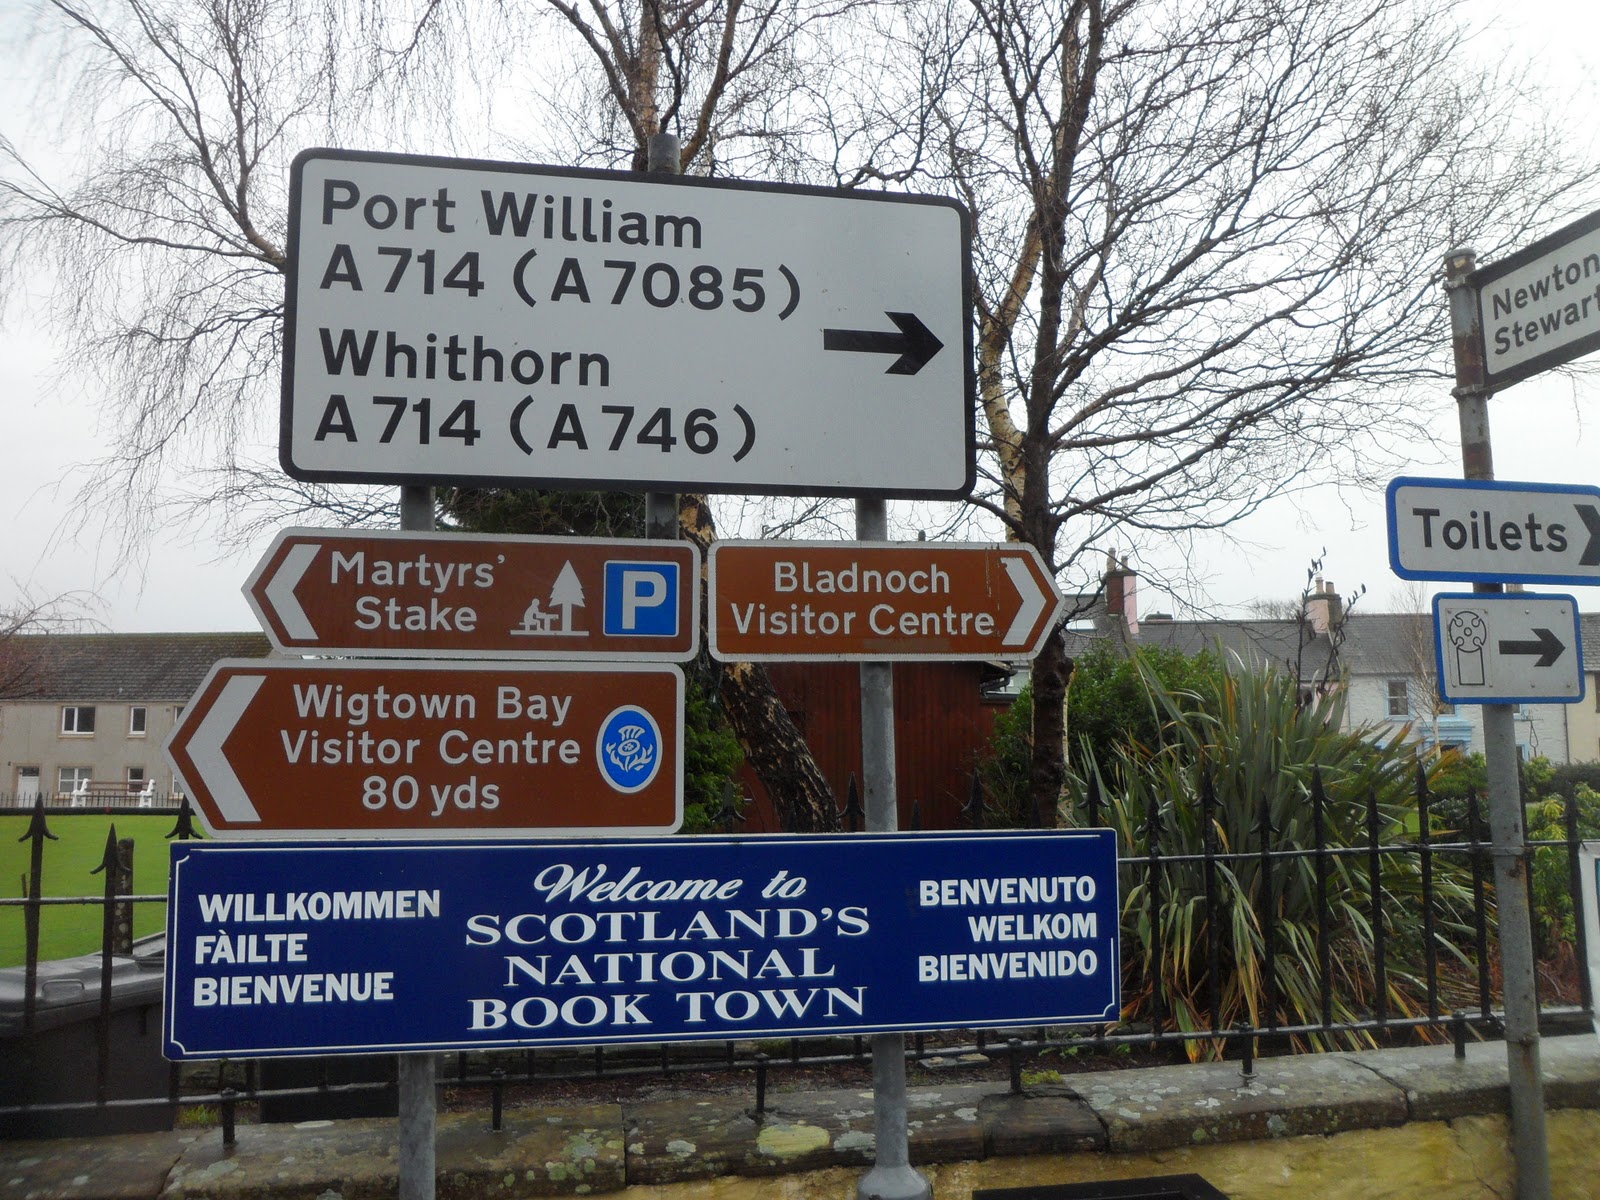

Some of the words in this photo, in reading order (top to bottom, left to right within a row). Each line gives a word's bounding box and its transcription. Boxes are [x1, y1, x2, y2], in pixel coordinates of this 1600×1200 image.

[323, 179, 456, 233] Port
[481, 190, 702, 249] William
[1492, 253, 1600, 321] Newton
[319, 328, 610, 387] Whithorn
[1412, 508, 1568, 553] Toilets
[331, 551, 505, 594] Martyrs'
[774, 561, 951, 594] Bladnoch
[354, 596, 477, 632] Stake
[622, 571, 667, 630] P
[731, 603, 856, 635] Visitor
[869, 604, 995, 635] Centre
[293, 684, 477, 725] Wigtown
[497, 686, 572, 726] Bay
[280, 730, 420, 764] Visitor
[438, 731, 580, 764] Centre
[362, 775, 419, 810] 80
[430, 775, 500, 817] yds
[534, 863, 744, 904] Welcome
[761, 869, 807, 899] to
[919, 875, 1097, 908] BENVENUTO
[198, 889, 441, 923] WILLKOMMEN
[465, 906, 870, 946] SCOTLAND'S
[967, 912, 1099, 943] WELKOM
[195, 931, 309, 965] FÀILTE
[503, 947, 836, 988] NATIONAL
[918, 948, 1099, 983] BIENVENIDO
[193, 971, 395, 1008] BIENVENUE
[466, 993, 654, 1031] BOOK
[674, 986, 868, 1023] TOWN
